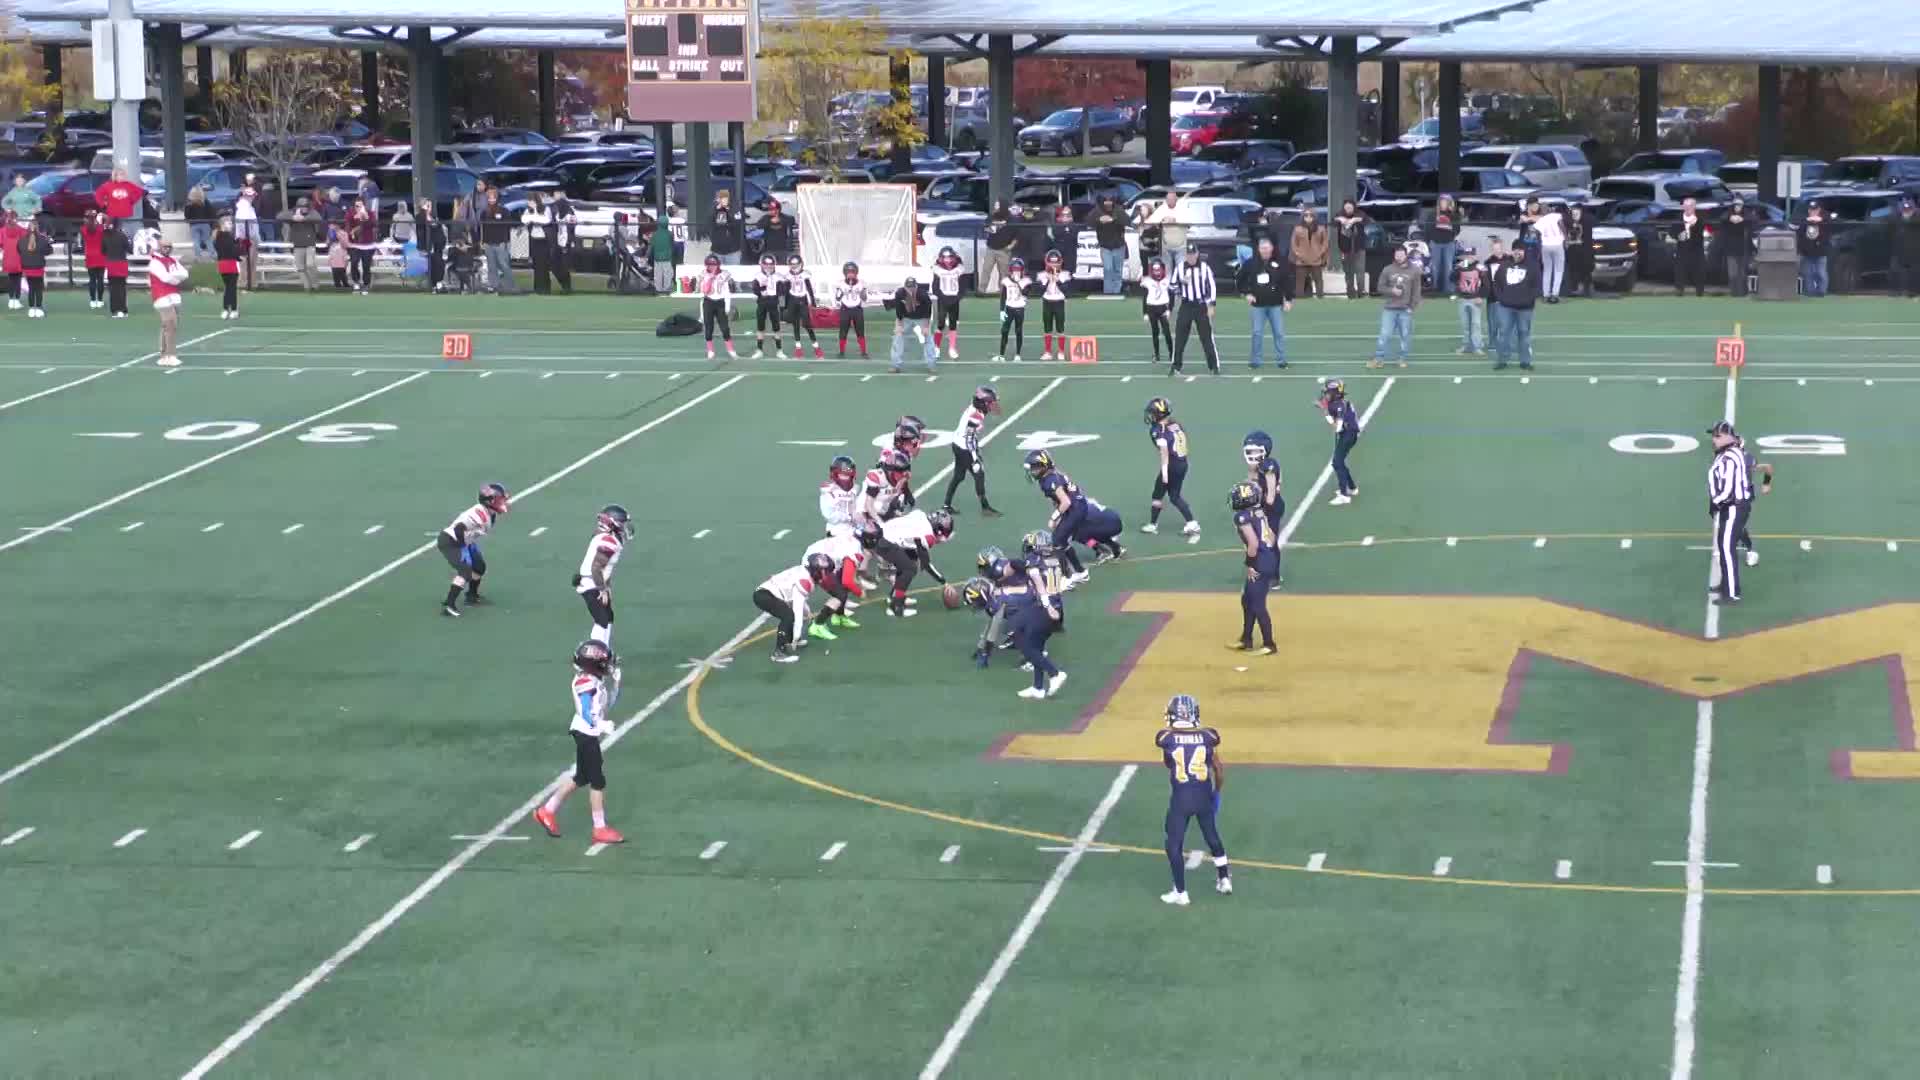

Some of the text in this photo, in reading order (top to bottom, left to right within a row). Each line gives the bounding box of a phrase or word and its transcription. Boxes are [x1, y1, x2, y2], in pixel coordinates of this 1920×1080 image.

[632, 60, 660, 71] BALL
[668, 60, 709, 71] STRIKE
[719, 60, 744, 71] OUT
[445, 336, 467, 356] 30
[1073, 340, 1094, 360] 40
[1719, 343, 1742, 362] 50
[1171, 745, 1208, 783] 14
